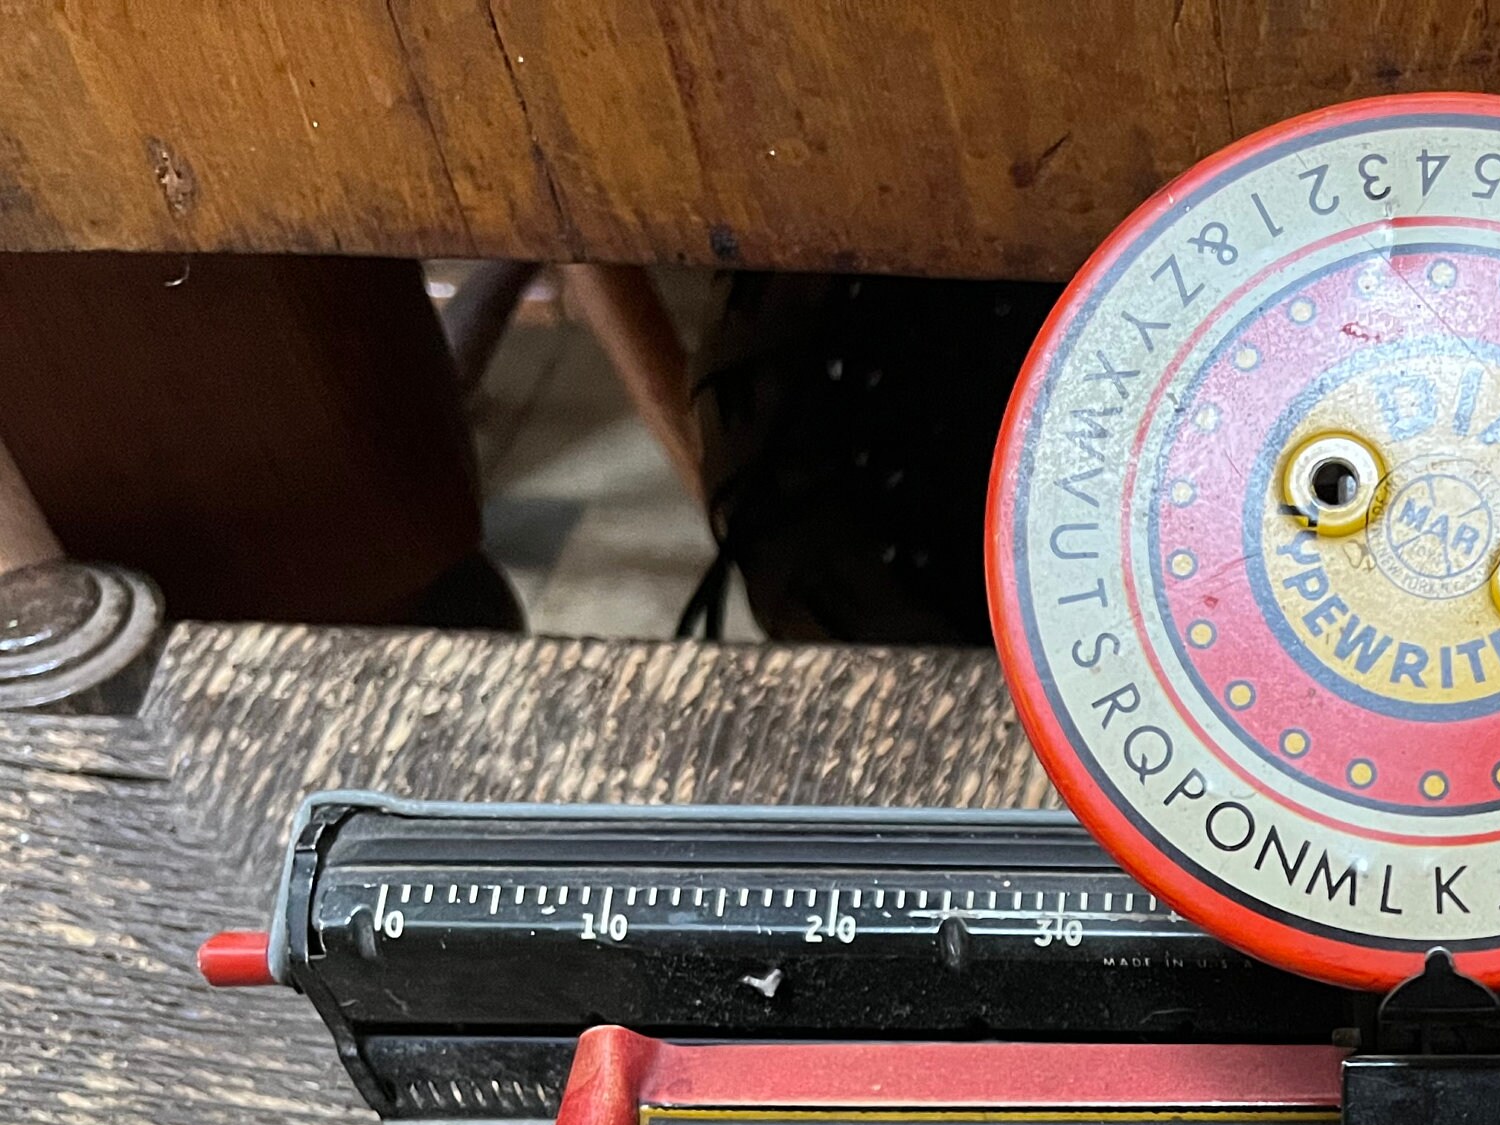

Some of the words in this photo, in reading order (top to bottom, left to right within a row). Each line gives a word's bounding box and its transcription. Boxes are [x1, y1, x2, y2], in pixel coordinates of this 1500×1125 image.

[1398, 497, 1480, 555] MAR
[1103, 957, 1150, 968] MADE
[1166, 957, 1184, 968] IN
